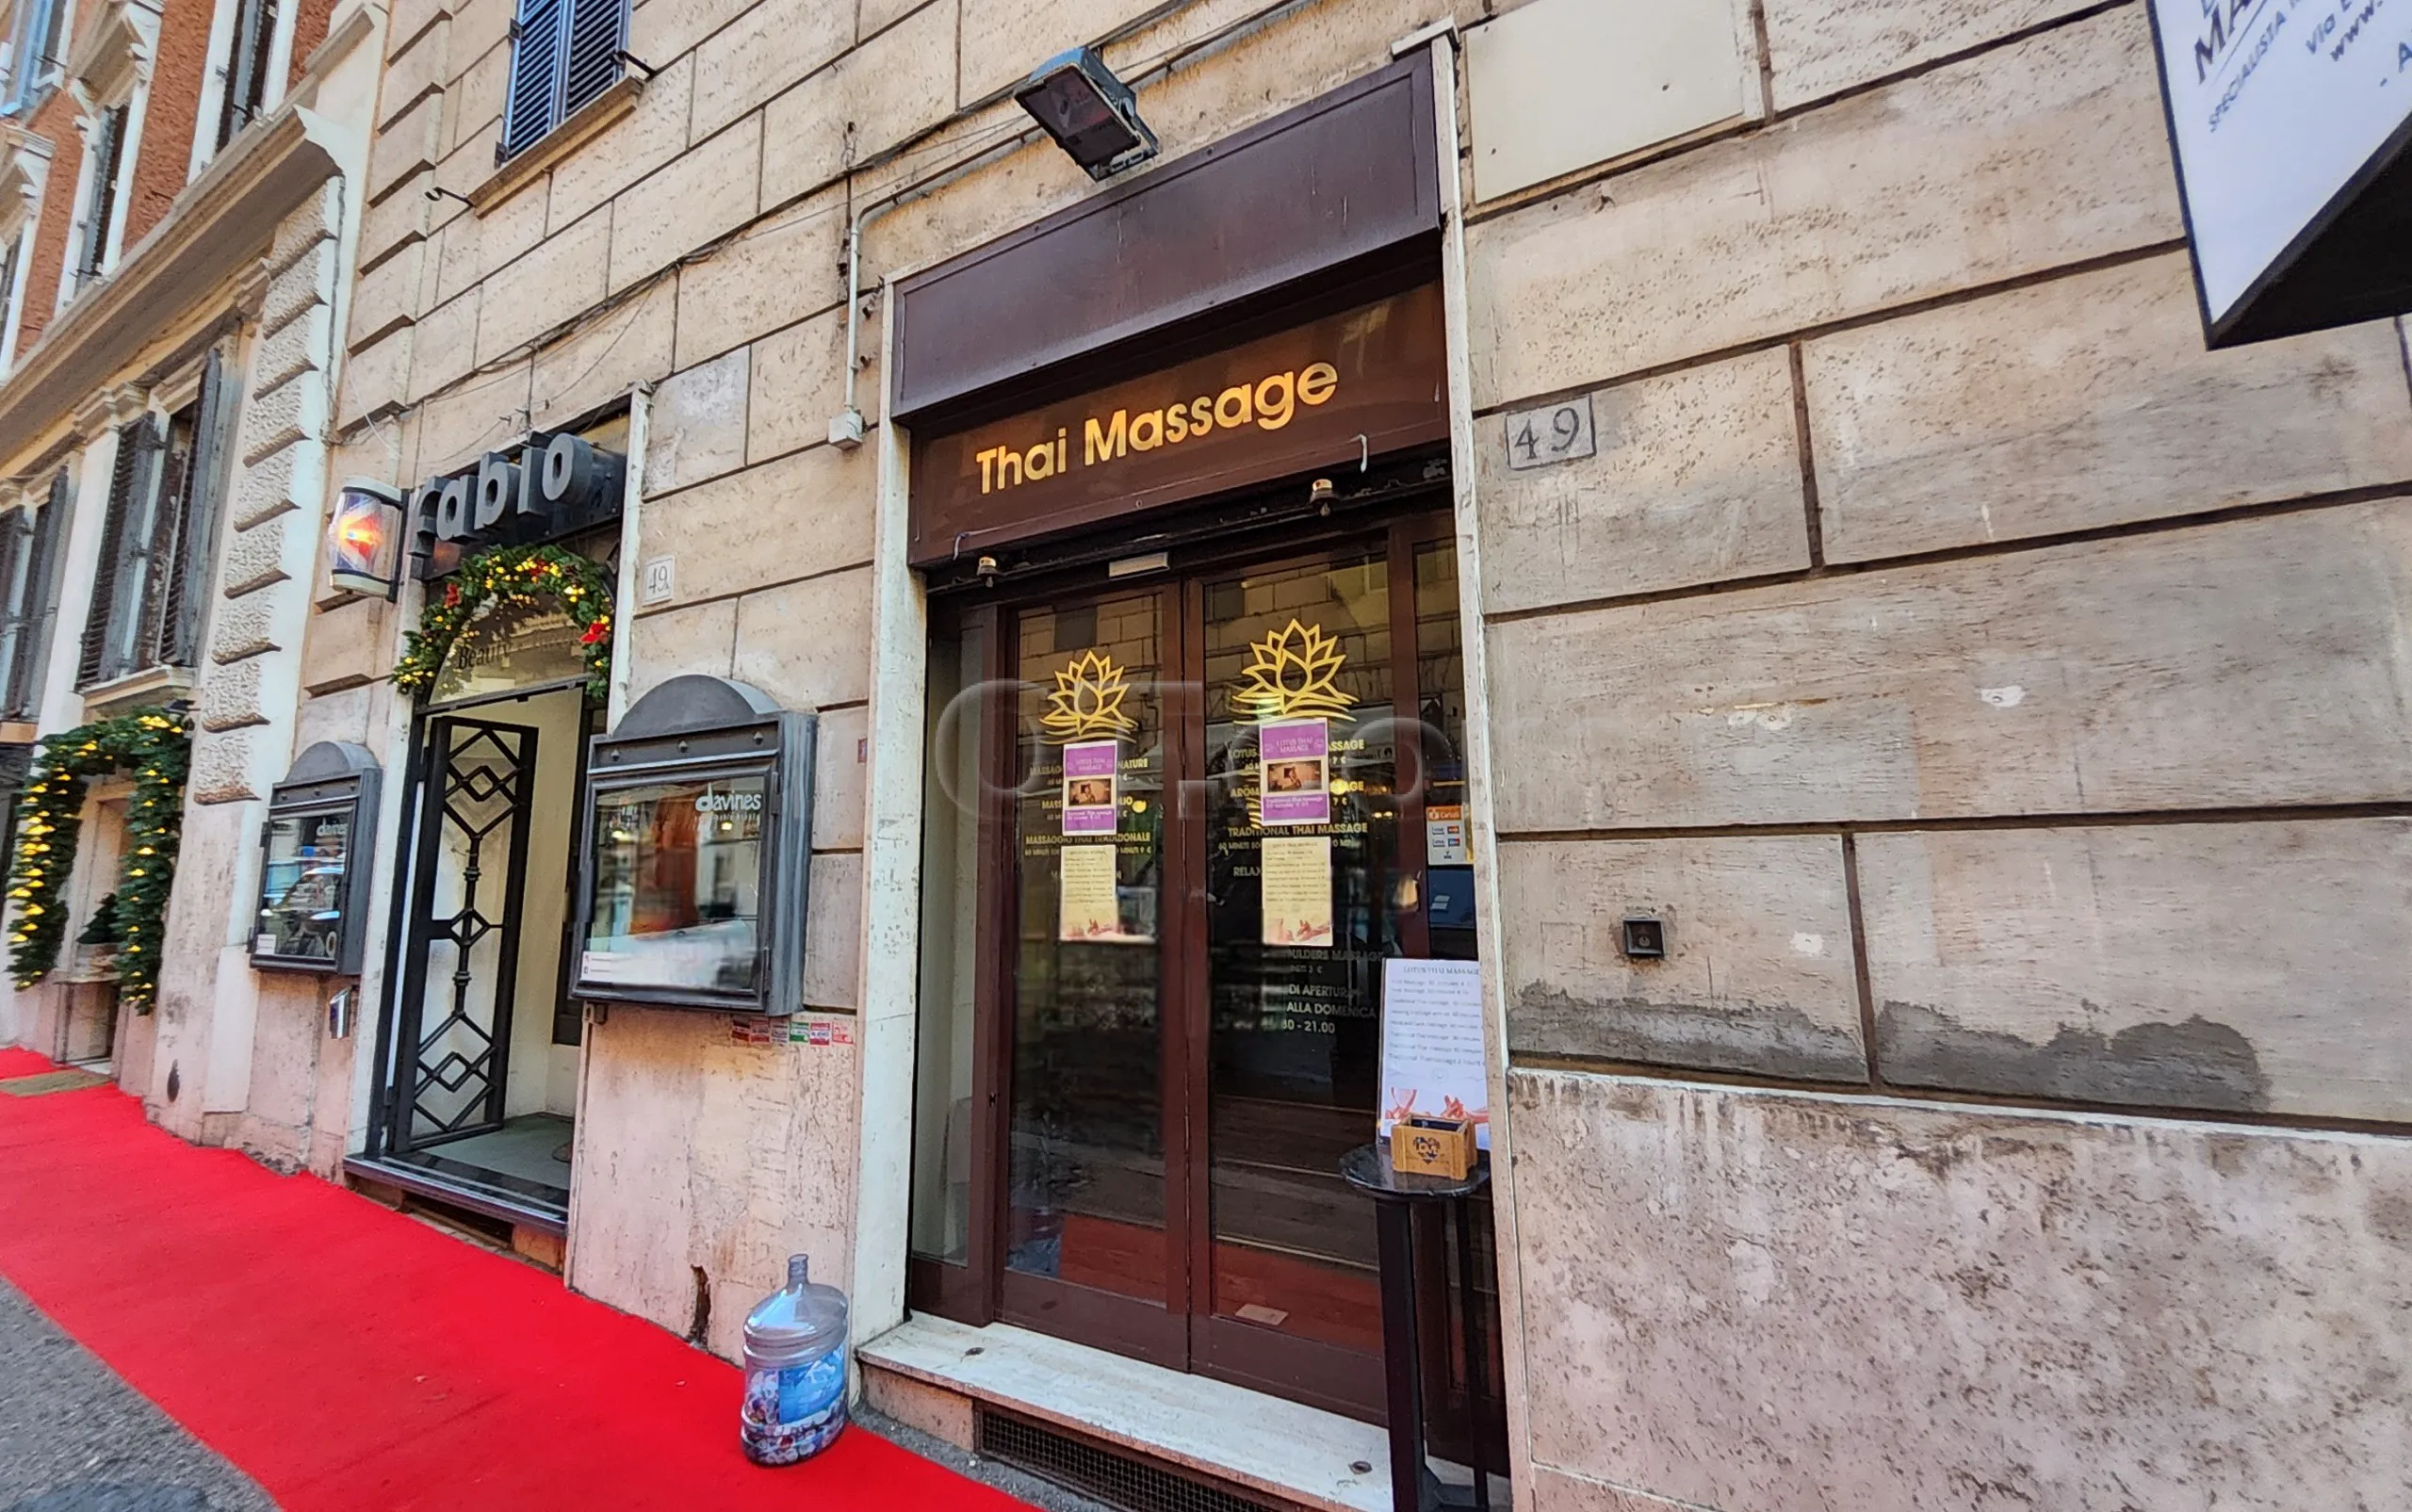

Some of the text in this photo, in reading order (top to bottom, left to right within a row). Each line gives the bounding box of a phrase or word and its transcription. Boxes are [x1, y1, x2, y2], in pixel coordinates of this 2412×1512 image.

[976, 362, 1338, 494] Thai Massage
[1513, 407, 1580, 460] 49
[695, 782, 761, 812] davines
[1228, 822, 1368, 837] TRADITIONAL THAI MASSAGE
[1289, 984, 1300, 995] DI
[1286, 1001, 1312, 1014] ALLA
[1314, 1002, 1377, 1017] DOMENICA
[1304, 1020, 1335, 1033] 21.00
